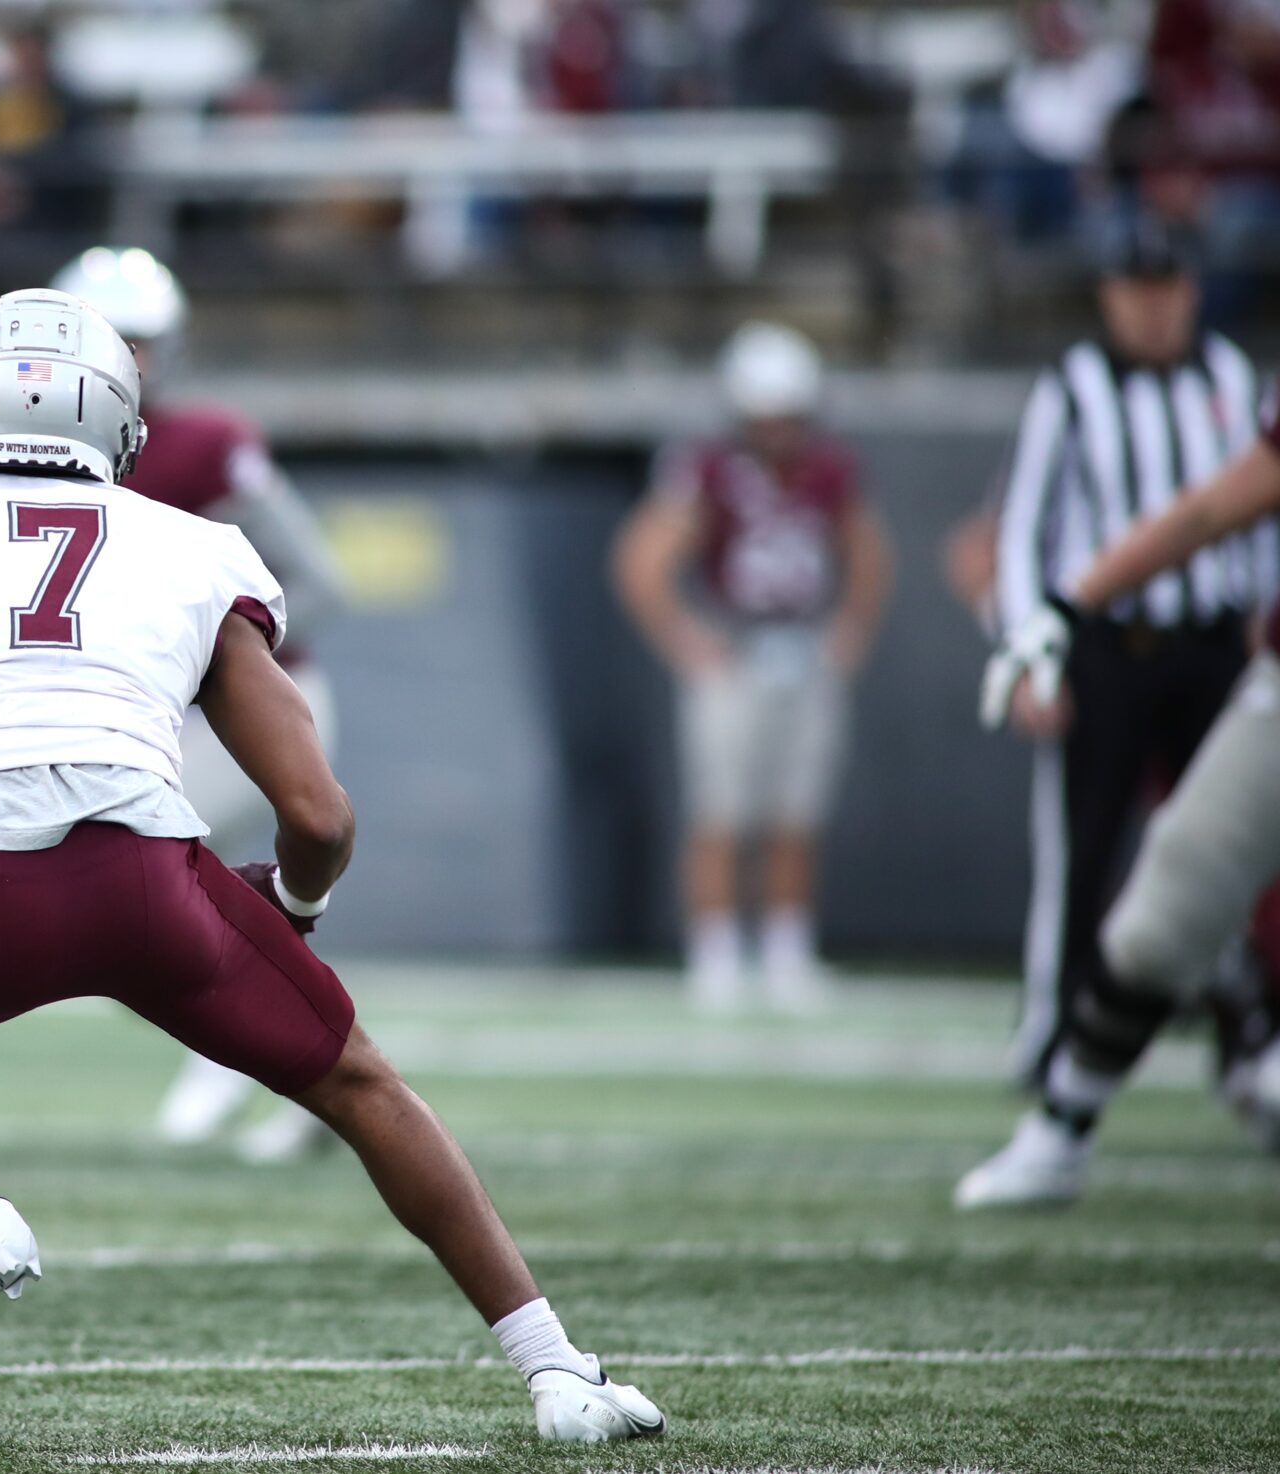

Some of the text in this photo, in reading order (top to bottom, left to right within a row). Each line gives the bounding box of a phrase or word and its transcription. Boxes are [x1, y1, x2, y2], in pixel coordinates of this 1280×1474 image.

[6, 443, 29, 454] WITH
[30, 445, 72, 455] MONTANA
[7, 501, 107, 651] 7
